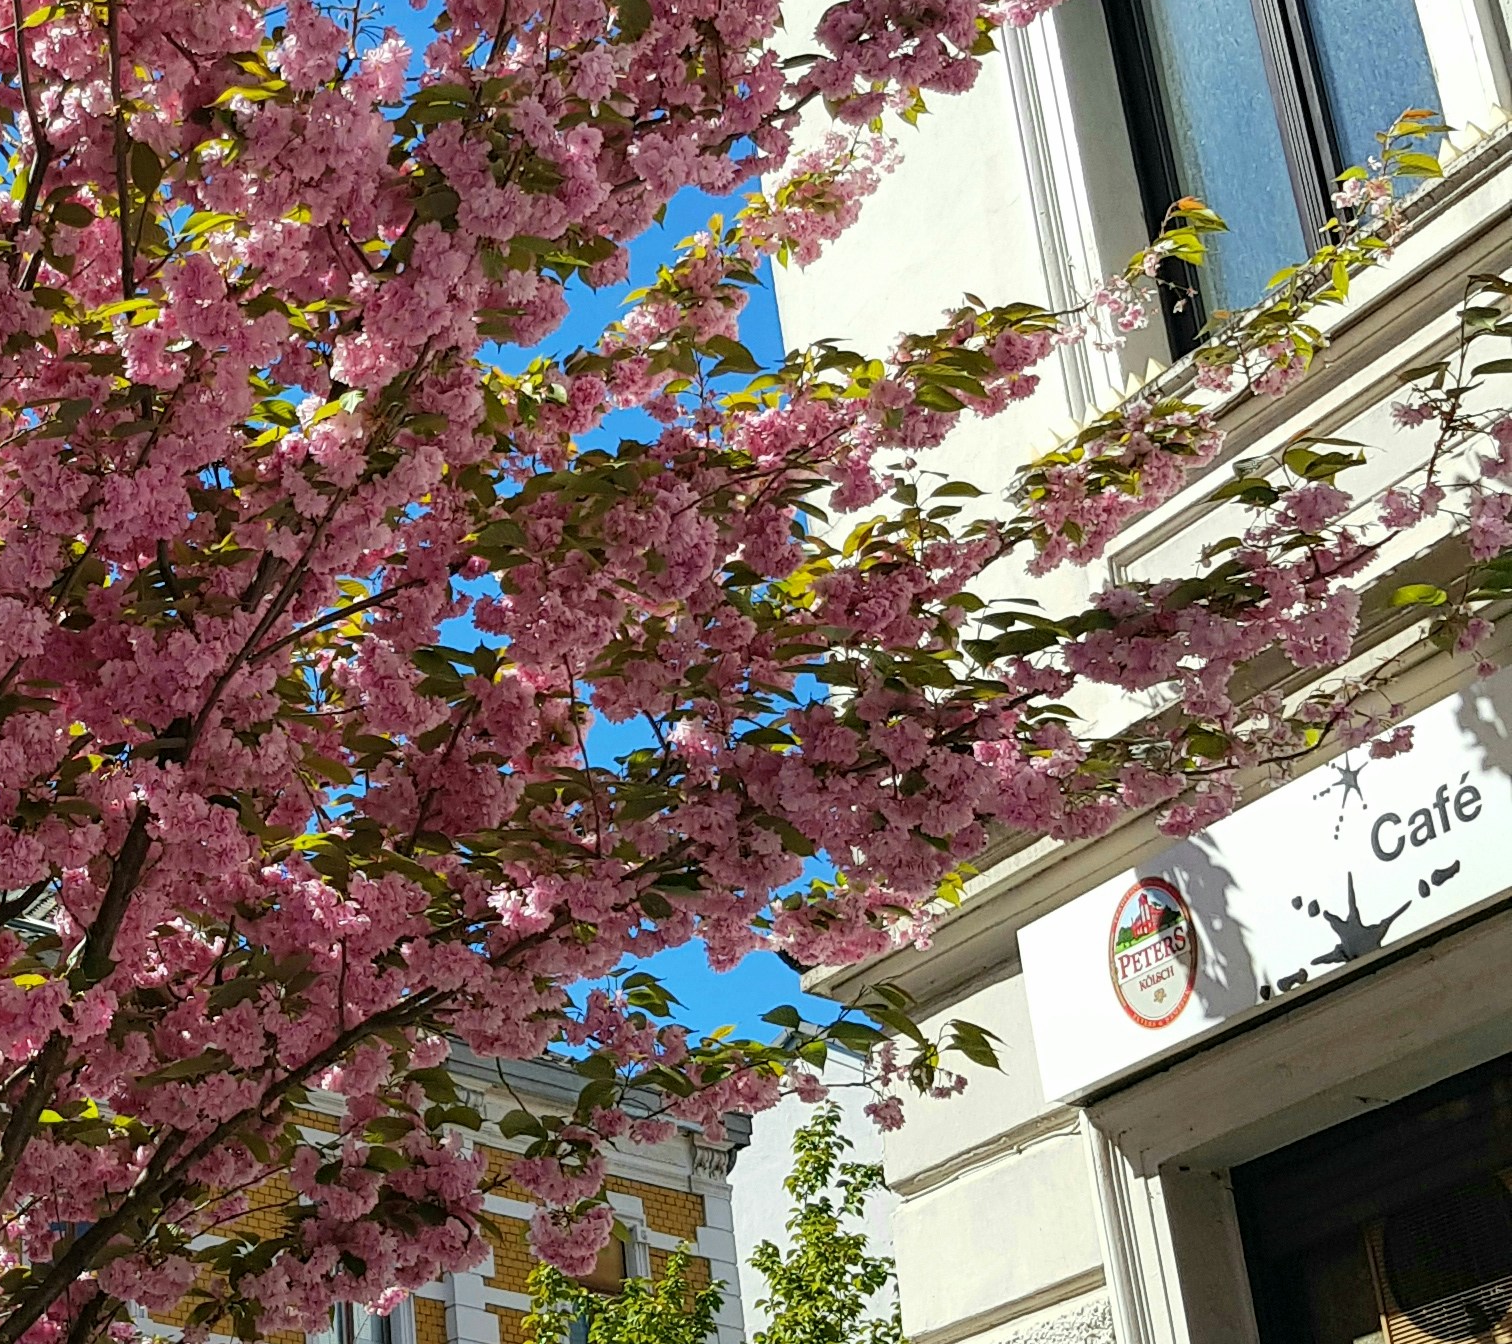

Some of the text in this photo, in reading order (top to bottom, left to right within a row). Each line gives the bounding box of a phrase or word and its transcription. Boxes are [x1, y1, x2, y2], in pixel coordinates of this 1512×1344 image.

[1371, 770, 1482, 862] Café
[1118, 926, 1186, 980] PETERS
[1139, 964, 1175, 992] KÖLSCH
